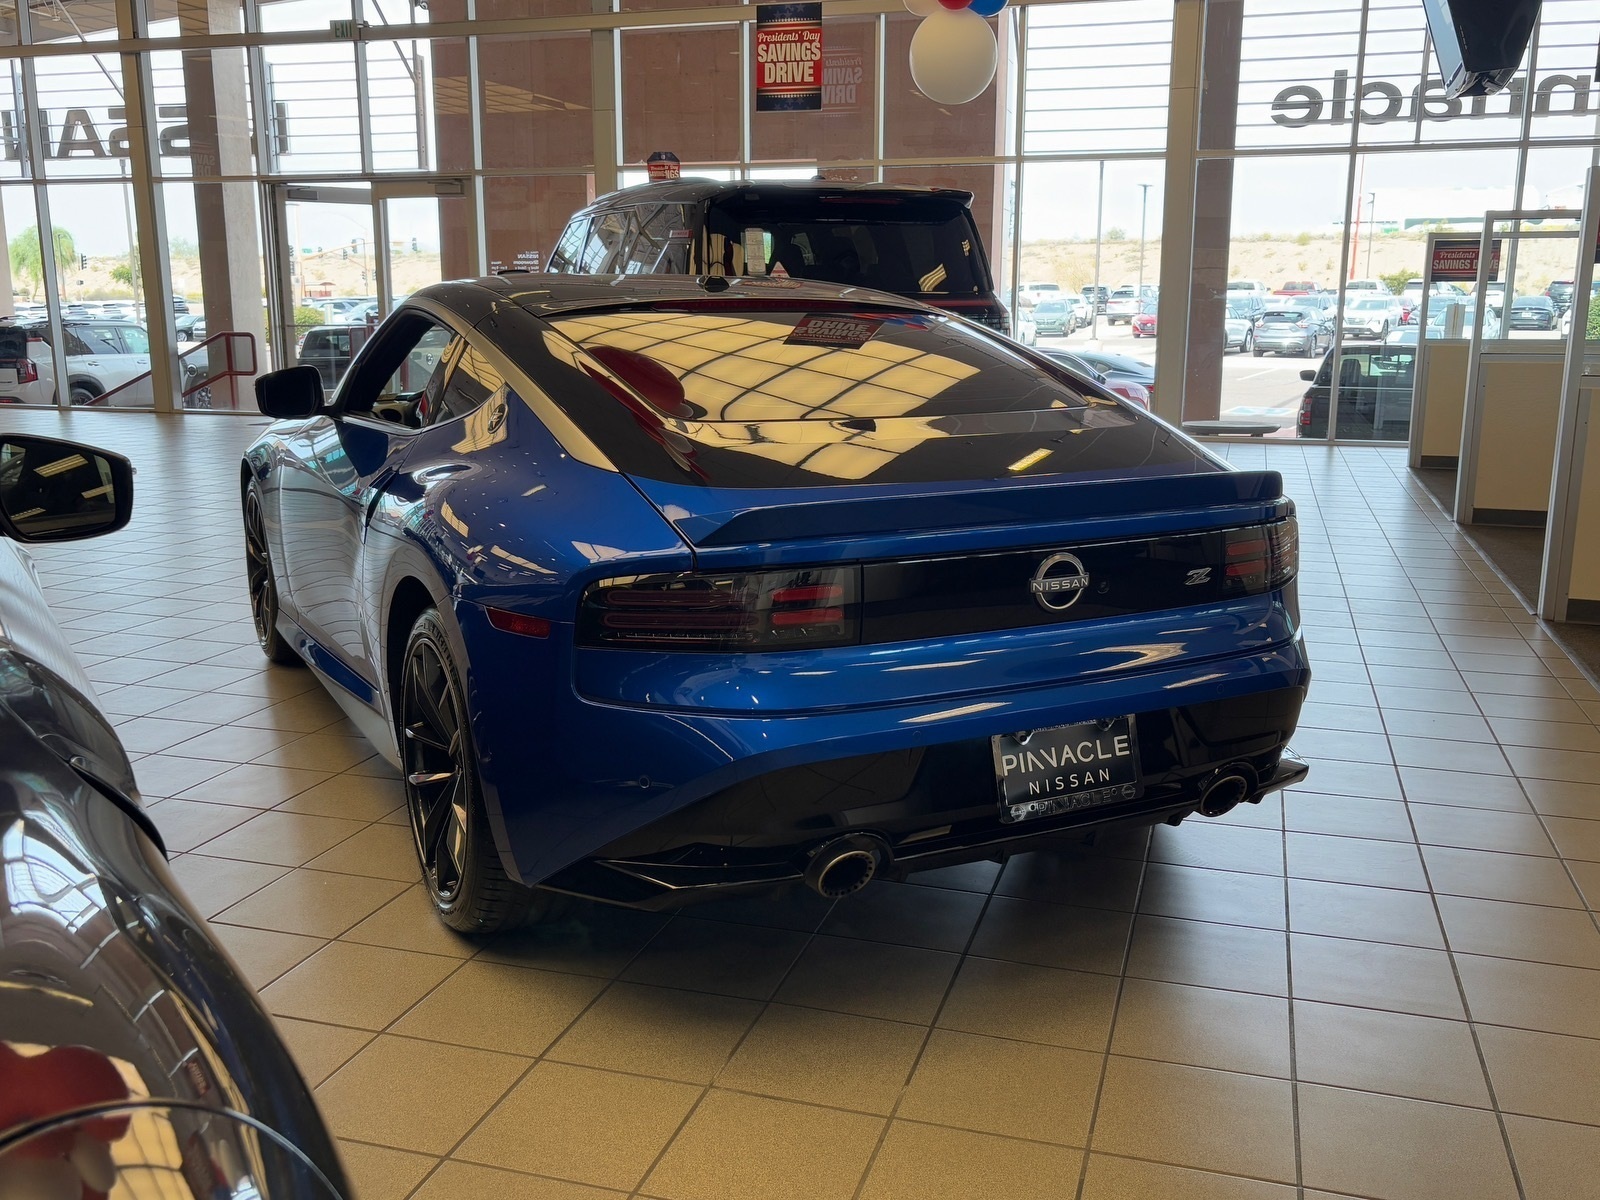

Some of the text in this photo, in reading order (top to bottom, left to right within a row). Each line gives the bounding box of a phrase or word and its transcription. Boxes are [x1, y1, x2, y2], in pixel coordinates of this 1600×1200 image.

[334, 22, 353, 38] EXIT
[757, 30, 821, 43] Presidents' Day
[757, 42, 821, 62] SAVINGS
[764, 61, 814, 84] DRIVE
[1432, 259, 1471, 270] SAVINGS
[1032, 576, 1089, 592] NISSAN
[1001, 734, 1131, 777] PINNACLE
[1028, 767, 1111, 796] NISSAN
